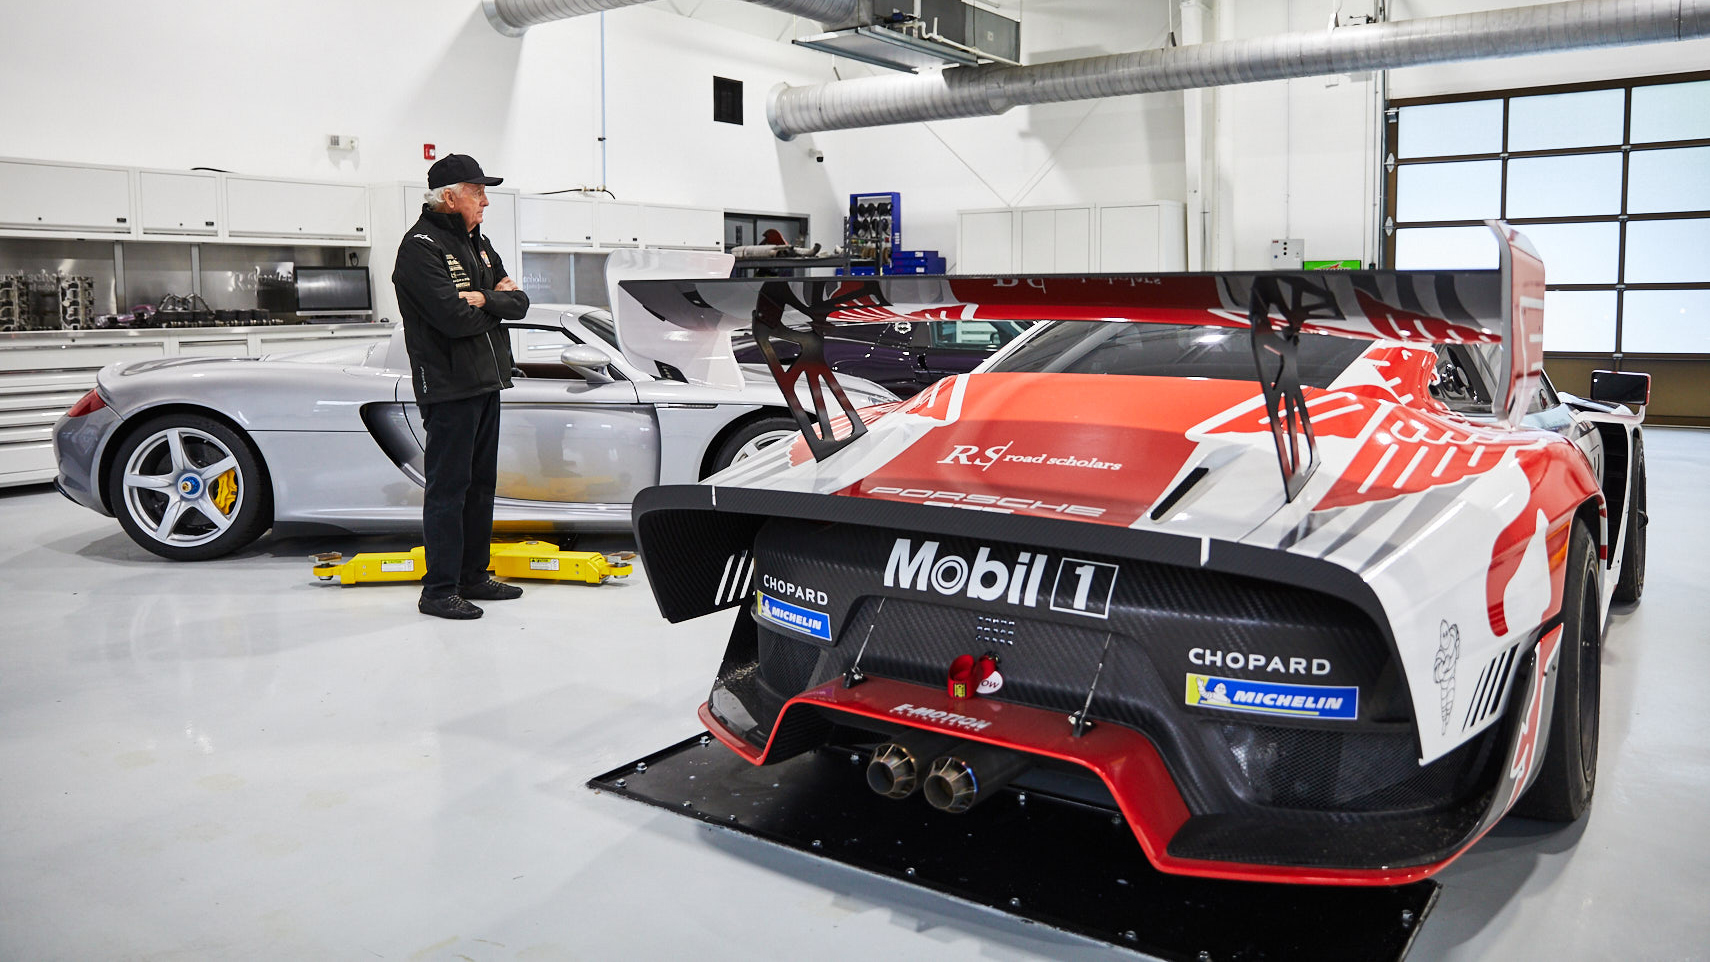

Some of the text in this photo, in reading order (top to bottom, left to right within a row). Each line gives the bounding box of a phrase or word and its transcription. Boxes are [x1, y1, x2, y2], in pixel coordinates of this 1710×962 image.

[936, 441, 1122, 472] RS road scholars
[866, 486, 1107, 517] PORSCHE
[883, 538, 1048, 607] Mobil
[763, 574, 829, 605] CHOPARD
[771, 606, 822, 630] MICHELIN
[1188, 647, 1332, 675] CHOPARD
[981, 679, 999, 689] OW
[1233, 690, 1344, 710] MICHELIN
[893, 703, 992, 729] E-MOTION
